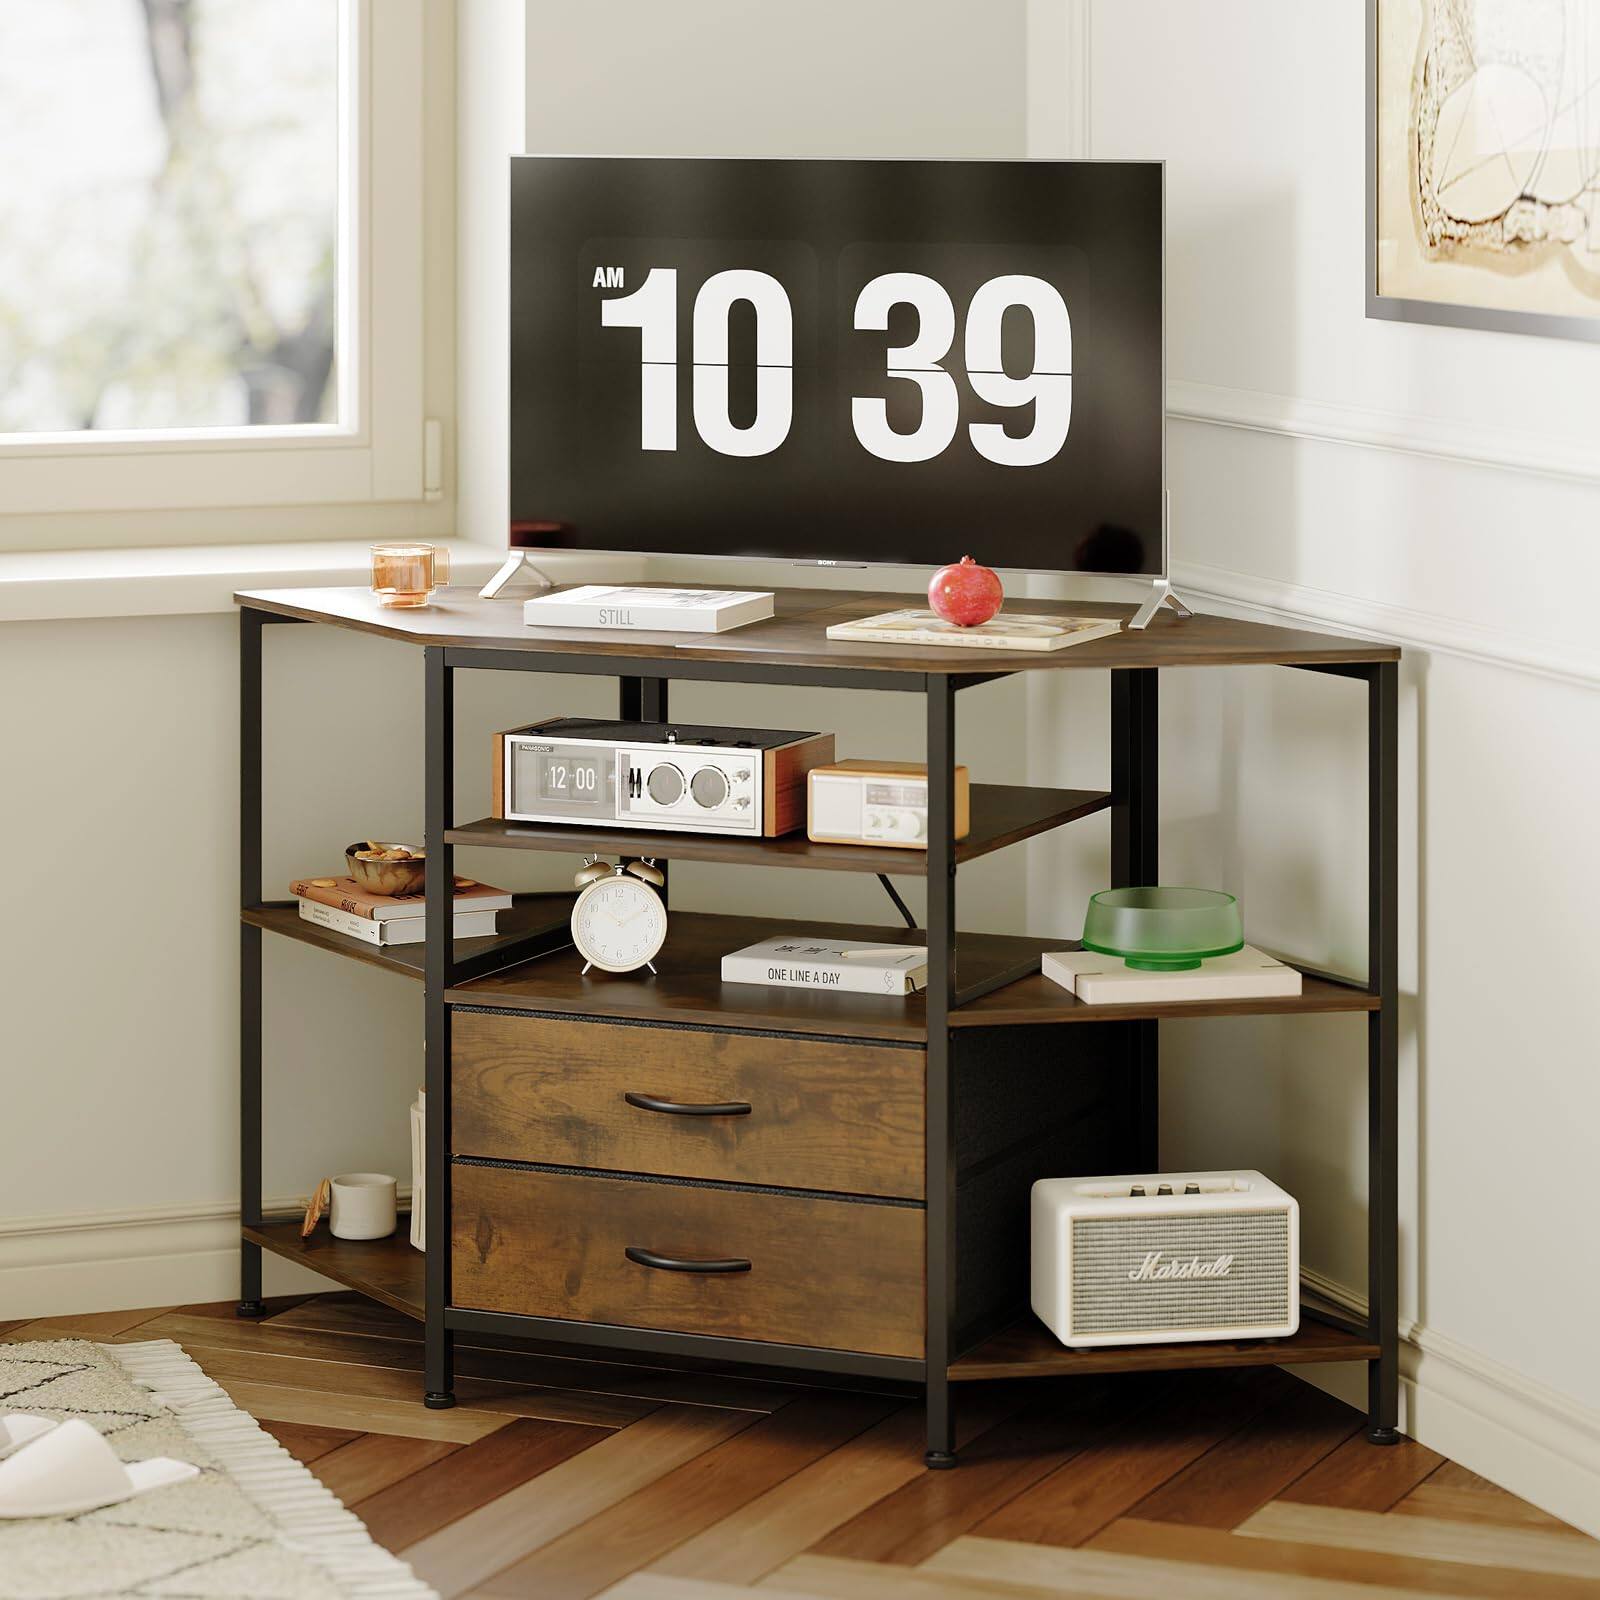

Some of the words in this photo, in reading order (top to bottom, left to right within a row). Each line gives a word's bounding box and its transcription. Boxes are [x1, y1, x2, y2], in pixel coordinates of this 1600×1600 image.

[592, 266, 625, 289] AM
[601, 268, 793, 457] 10
[851, 272, 1073, 467] 39
[599, 608, 635, 625] STILL
[550, 766, 567, 789] 12
[575, 767, 596, 790] 00
[615, 888, 624, 898] 12
[768, 967, 787, 981] ONE
[789, 969, 811, 983] LINE
[812, 971, 820, 983] A
[822, 972, 841, 985] DAY
[1128, 1251, 1234, 1281] Marshall
